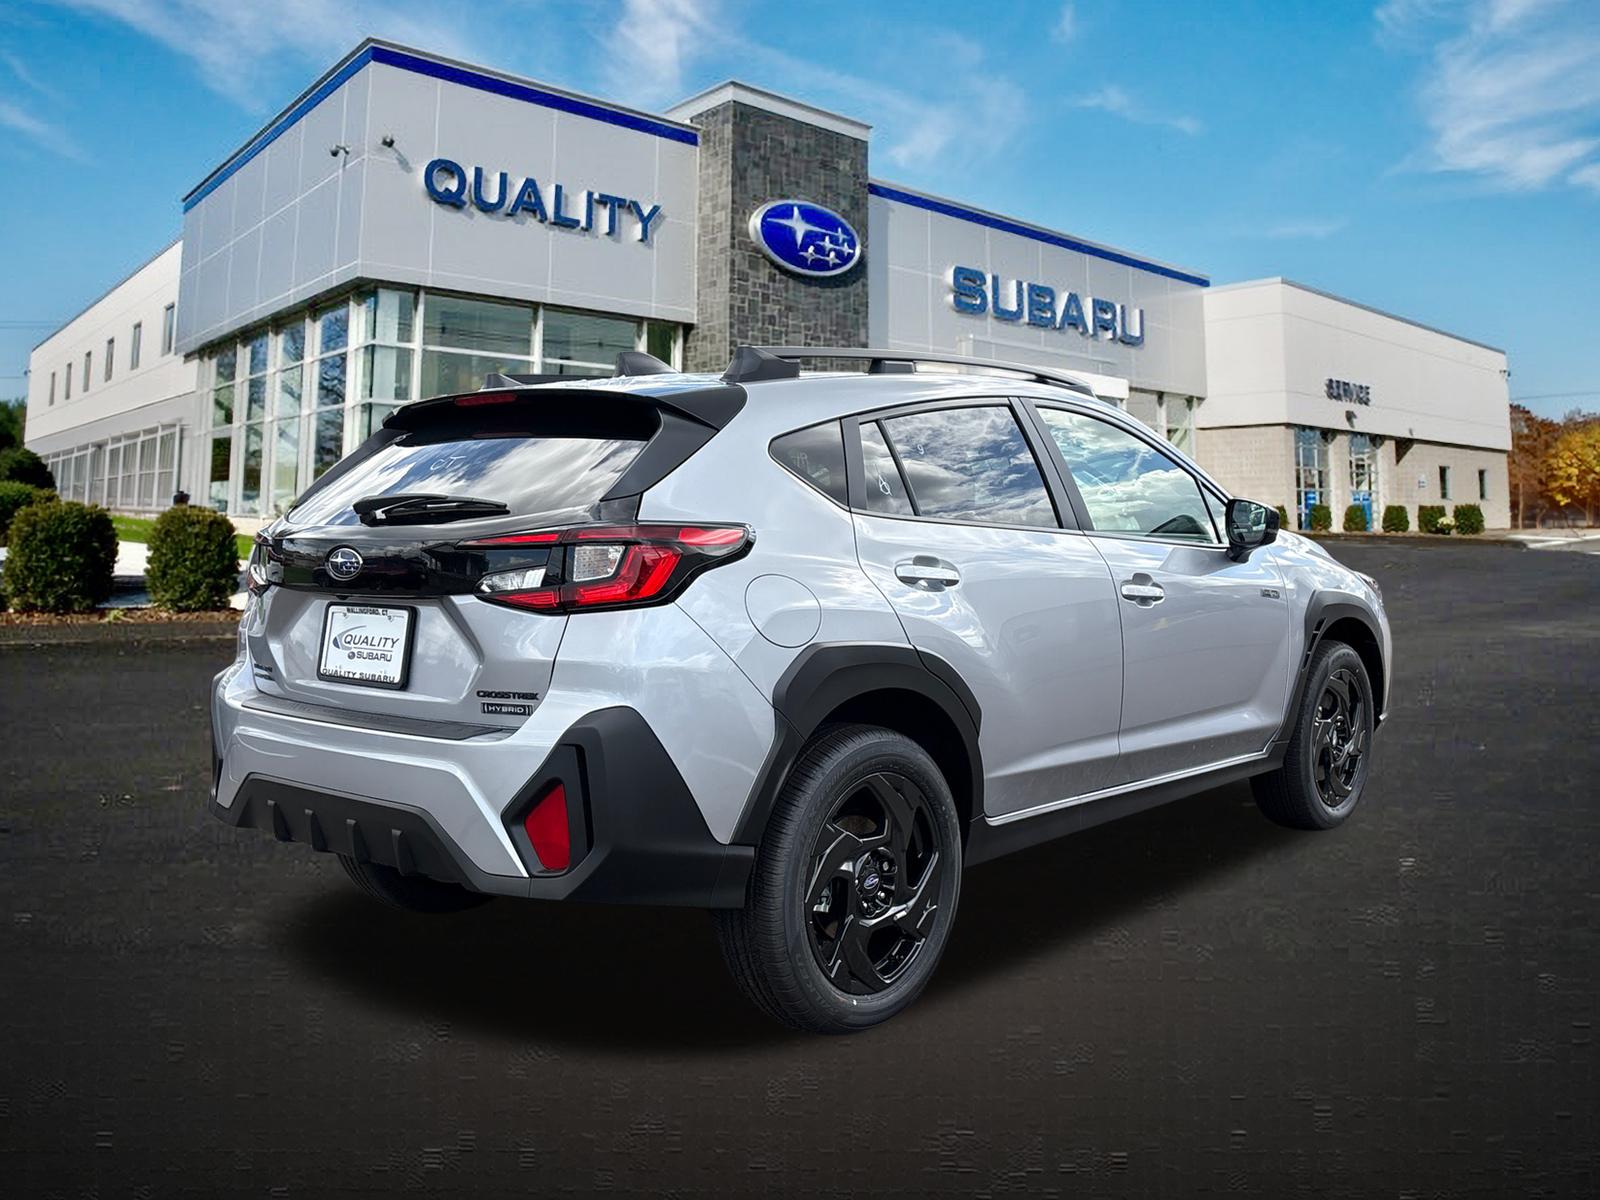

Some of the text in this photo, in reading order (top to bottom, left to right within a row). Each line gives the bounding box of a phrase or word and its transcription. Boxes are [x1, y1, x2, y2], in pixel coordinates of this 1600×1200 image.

[424, 158, 661, 243] QUALITY
[950, 266, 1145, 346] SUBARU
[1325, 378, 1370, 406] SERVICE
[343, 634, 400, 648] QUALITY
[356, 651, 393, 662] SUBARU
[322, 668, 396, 683] QUALITY SUBARU
[476, 690, 540, 701] CROSSTREK
[488, 705, 525, 713] HYBRID
